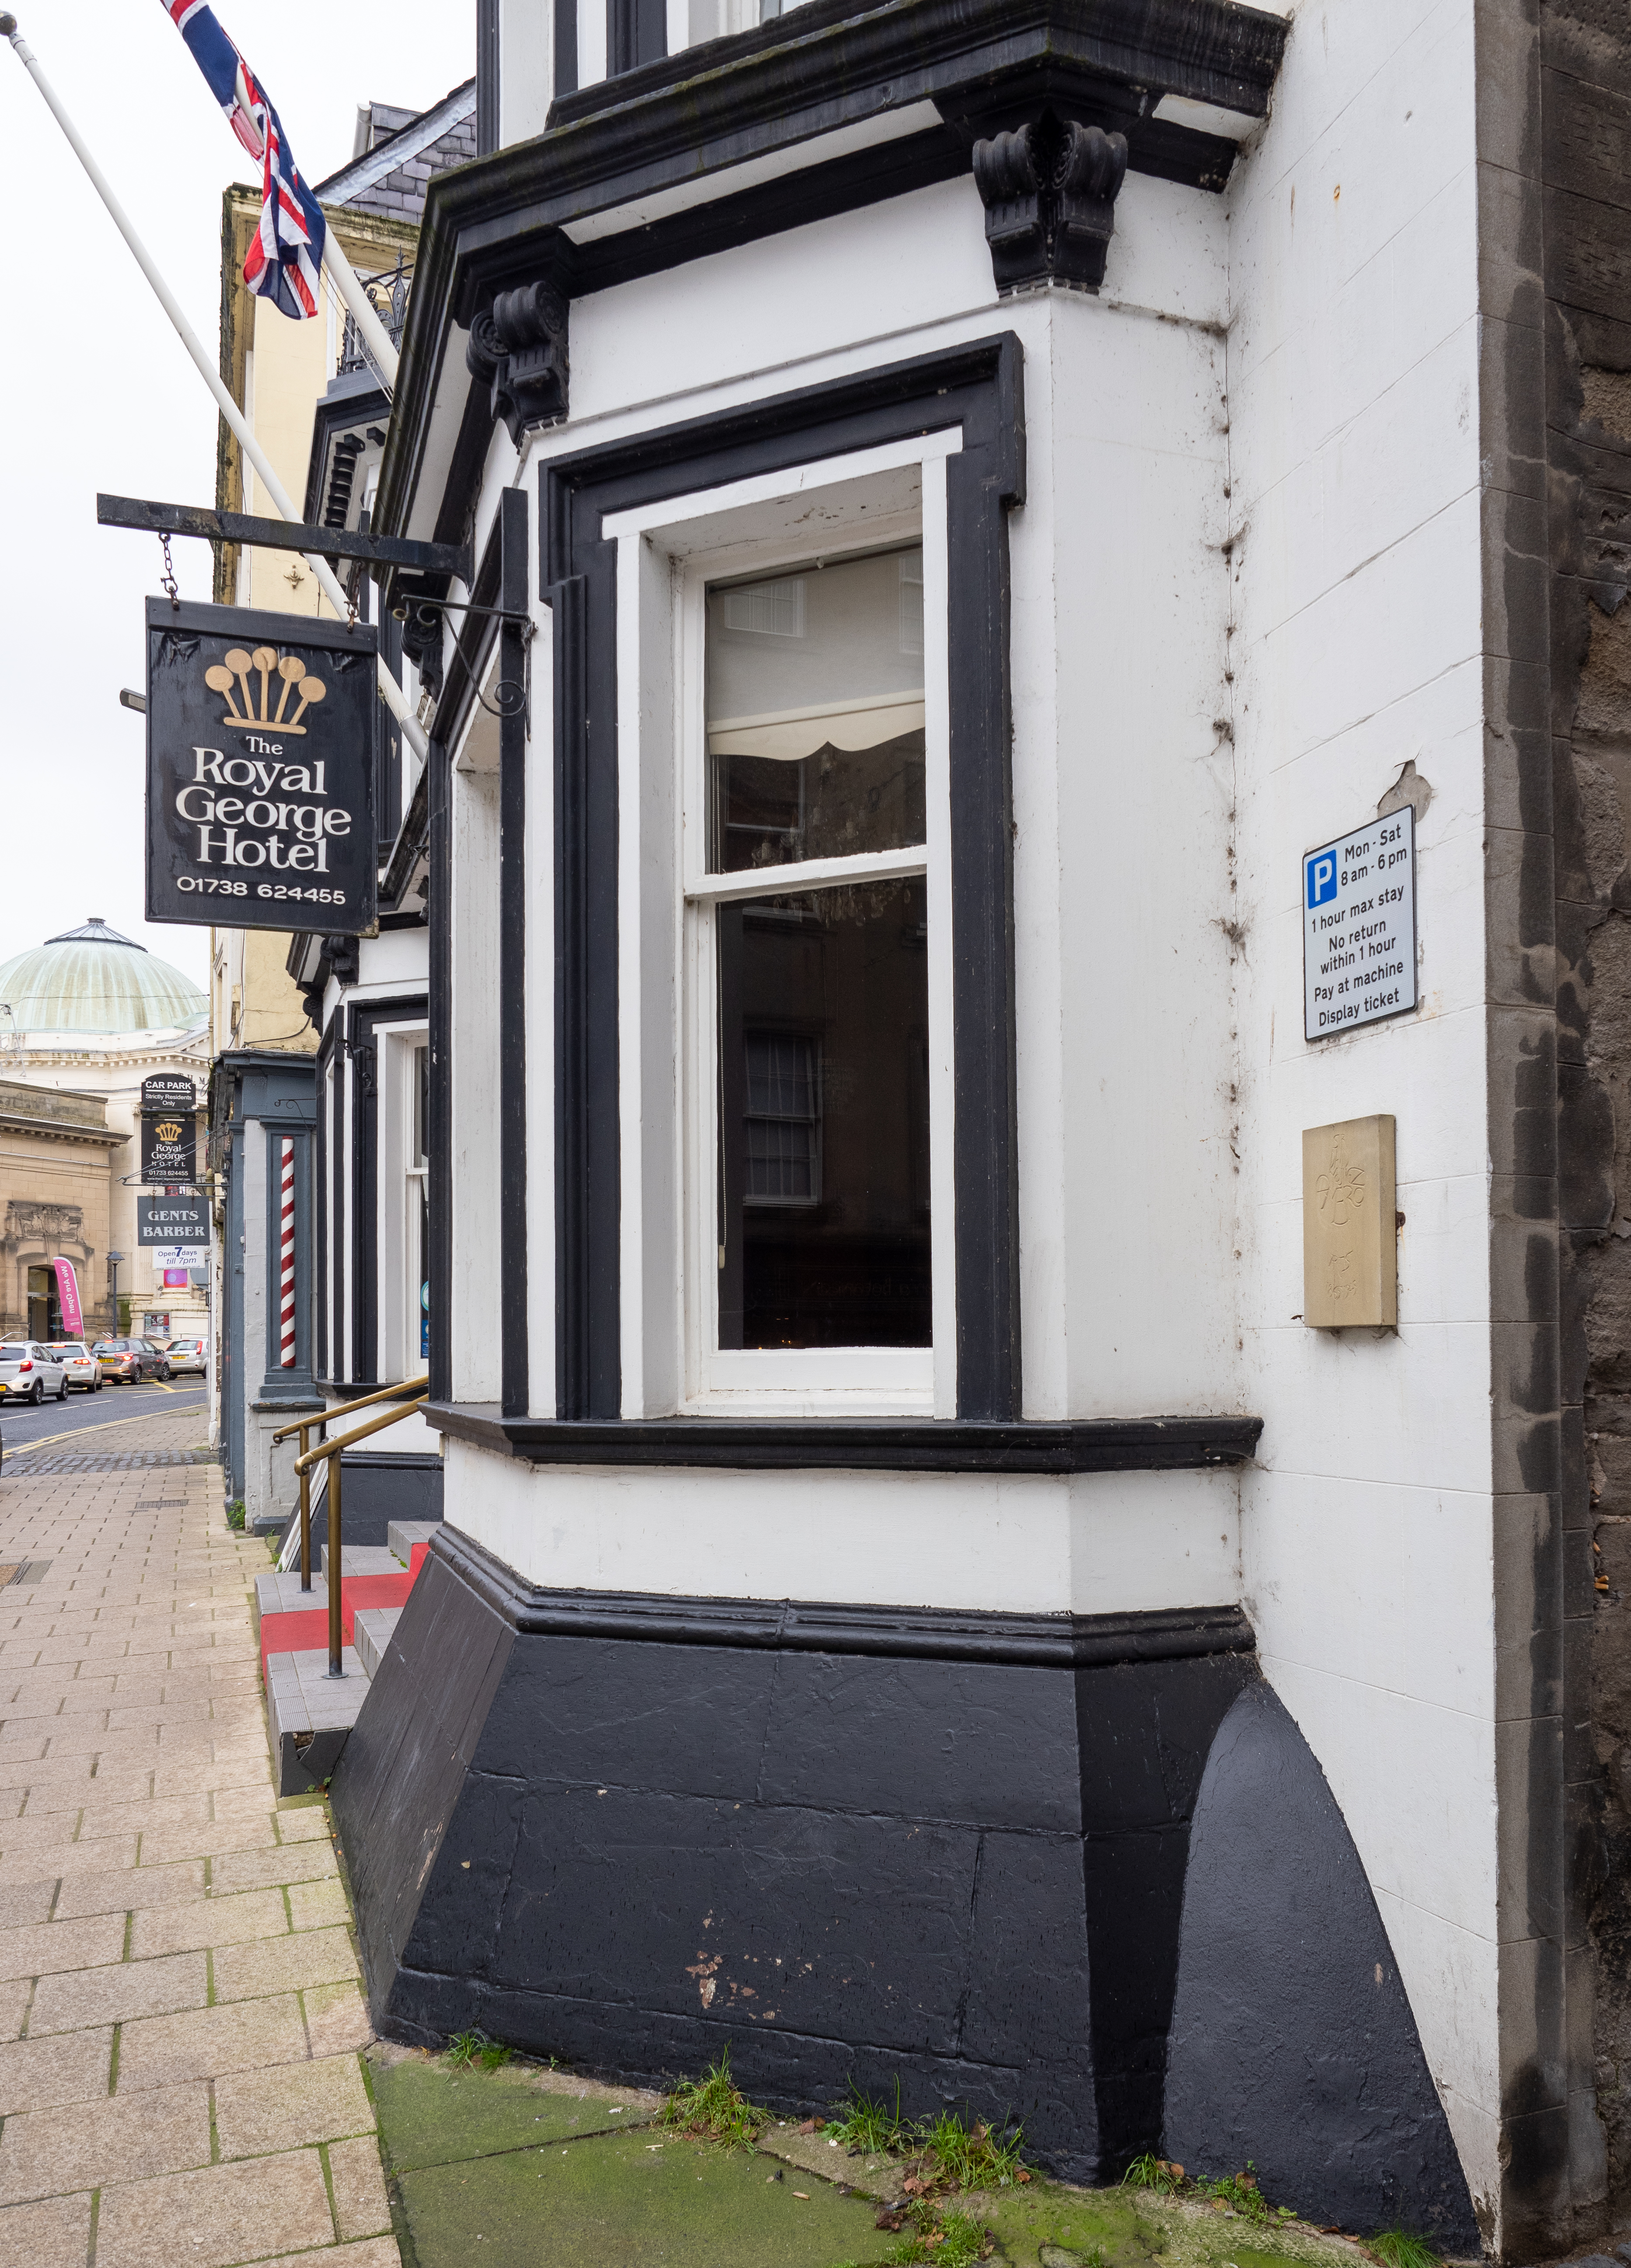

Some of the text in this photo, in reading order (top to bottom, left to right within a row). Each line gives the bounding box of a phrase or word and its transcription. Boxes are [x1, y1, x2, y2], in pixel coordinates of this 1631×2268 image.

[246, 736, 283, 755] The
[192, 747, 328, 796] Royal
[176, 786, 352, 841] George
[196, 825, 330, 872] Hotel
[1345, 841, 1369, 863] Mon
[1380, 824, 1401, 846] Sat
[1314, 858, 1333, 902] P
[1341, 871, 1348, 886] 8
[1351, 866, 1368, 882] am
[1378, 854, 1385, 869] 6
[1388, 848, 1407, 869] pm
[177, 876, 346, 905] 01738 624455
[1312, 885, 1404, 933] 1 hour max stay
[1320, 936, 1396, 974] within 1 hour
[1329, 920, 1386, 953] No return
[1315, 962, 1403, 1002] Pay at machine
[1319, 987, 1400, 1027] Display ticket
[151, 1152, 186, 1162] George
[156, 1144, 182, 1154] Royal
[143, 1226, 206, 1237] BARBER
[148, 1210, 199, 1221] GENTS
[175, 1246, 183, 1257] 7
